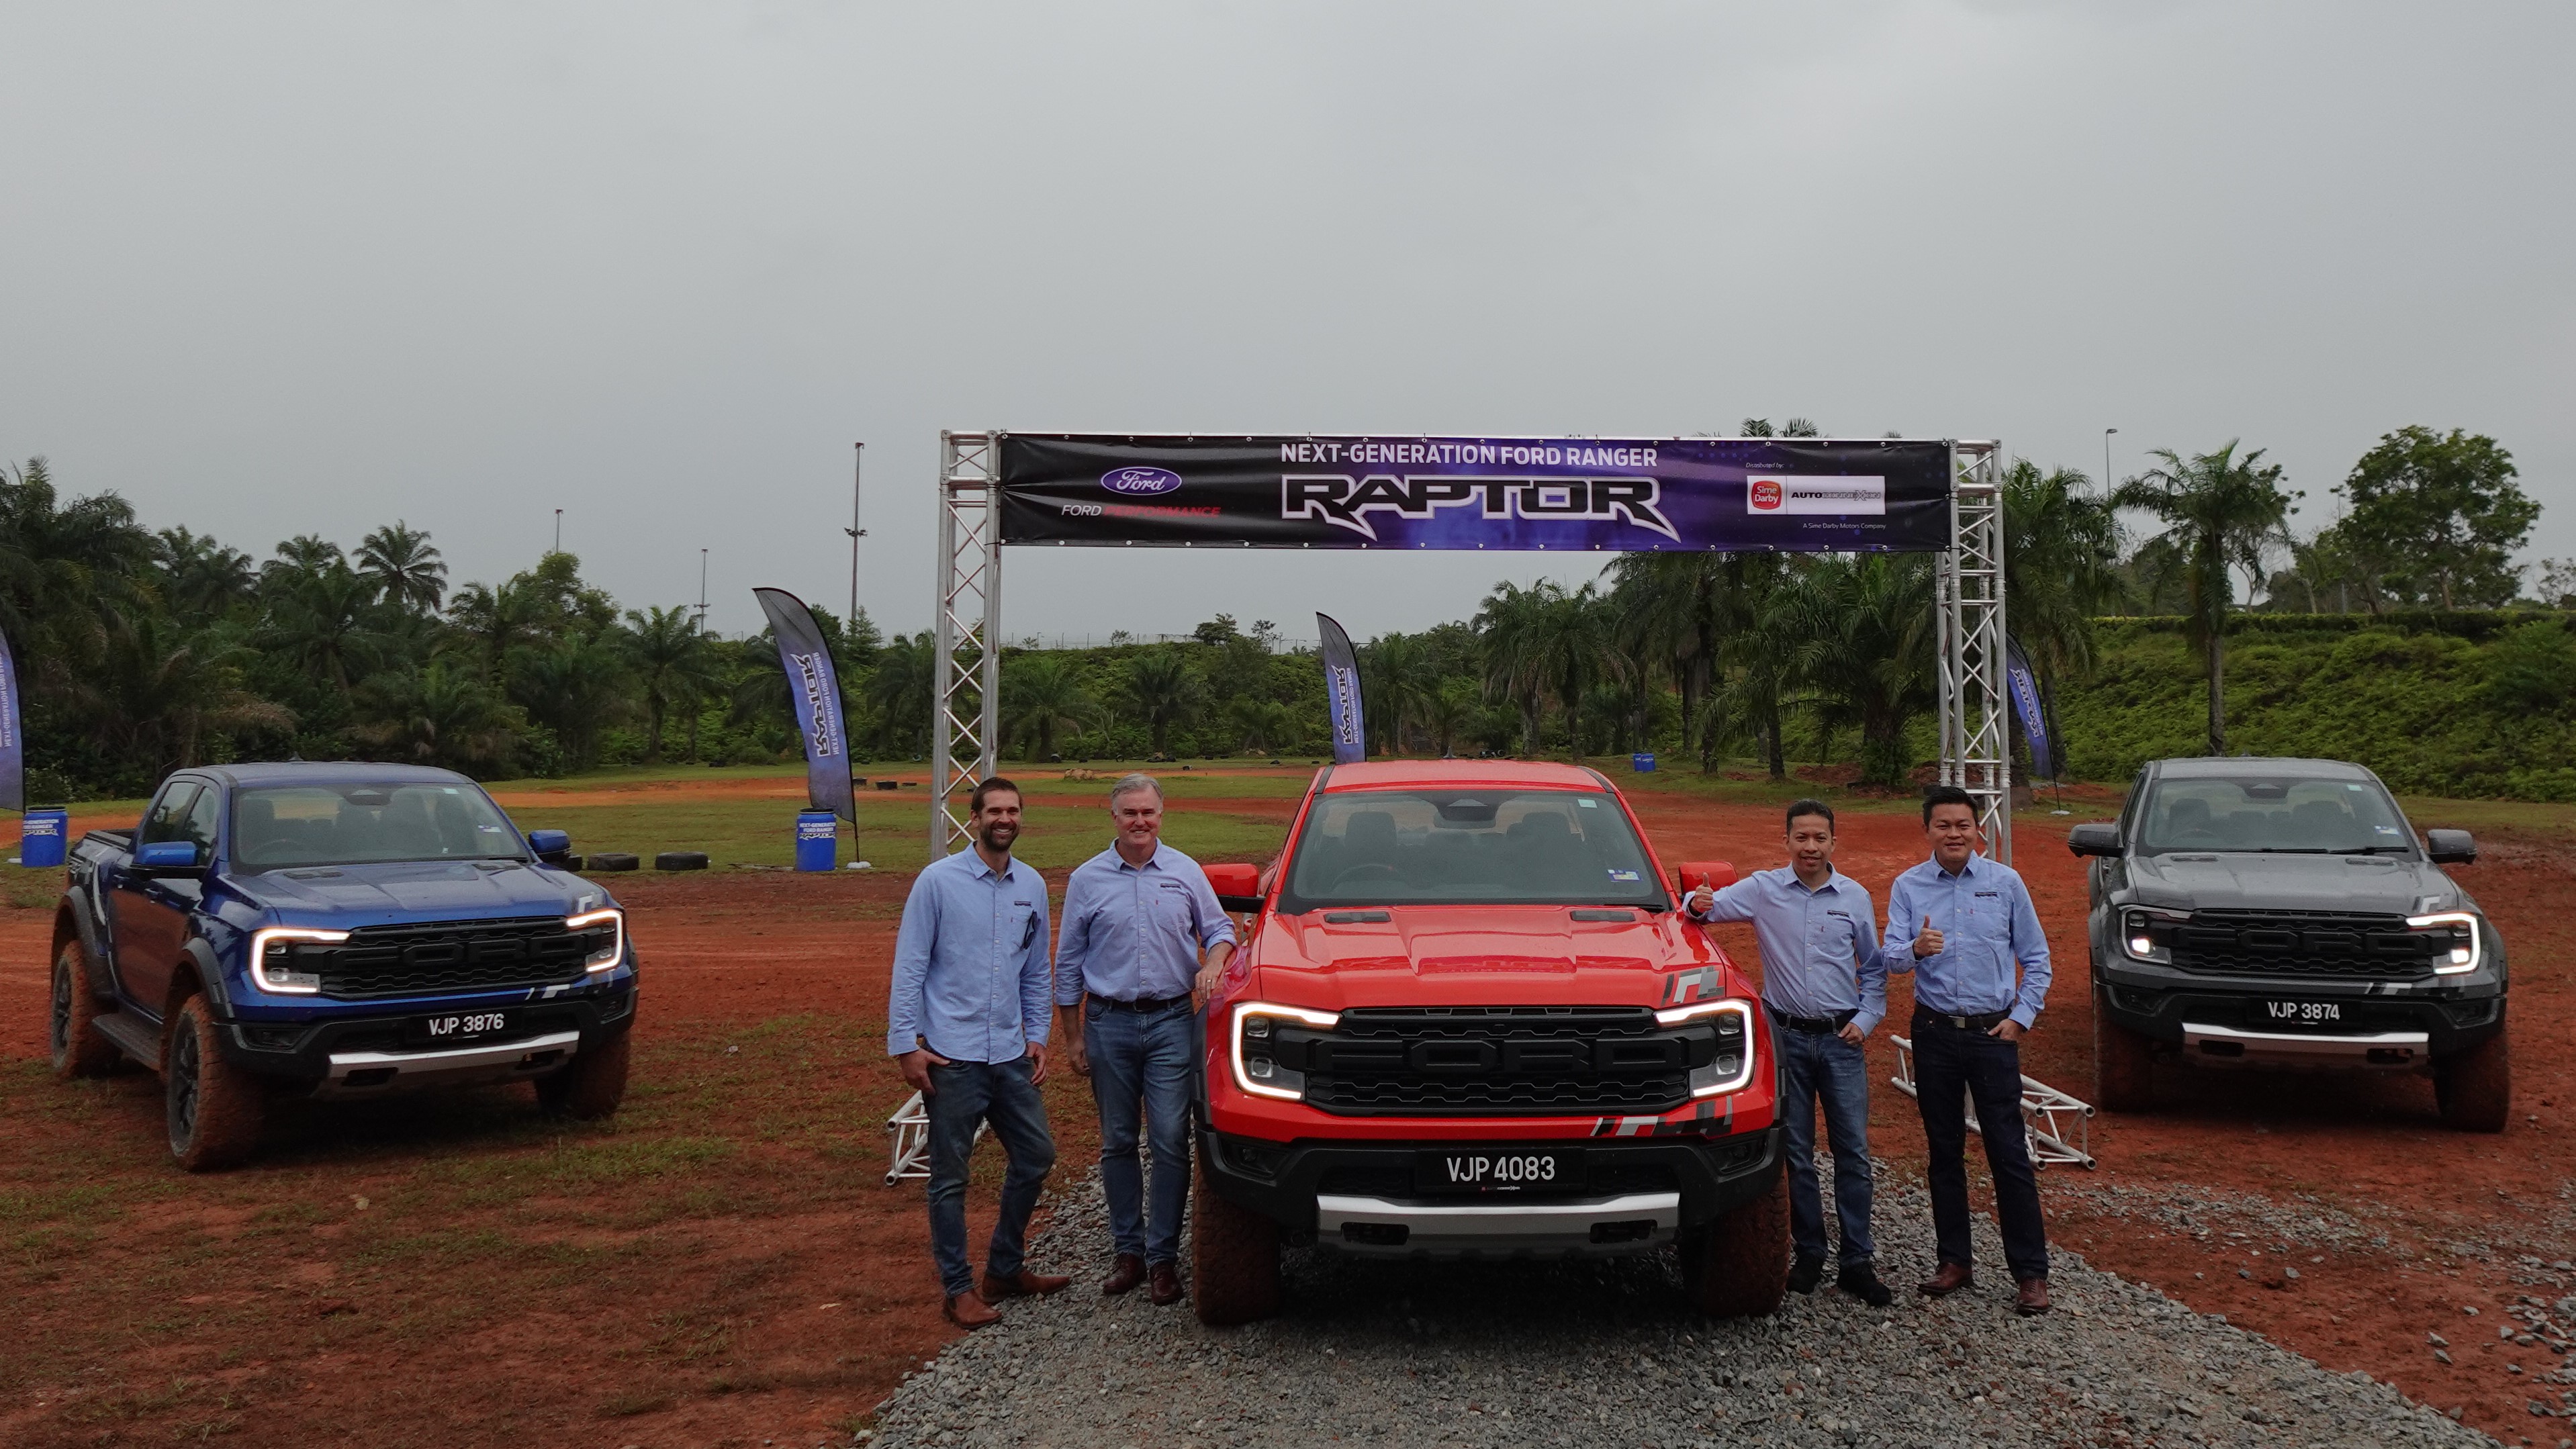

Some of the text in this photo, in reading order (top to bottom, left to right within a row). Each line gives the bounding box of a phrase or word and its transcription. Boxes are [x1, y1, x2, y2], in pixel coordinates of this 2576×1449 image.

[1281, 443, 1657, 467] NEXT-GENERATION FORD RANGER
[1116, 470, 1167, 491] Ford
[1757, 485, 1777, 494] Sime
[1282, 474, 1682, 543] RAPTOR
[1755, 494, 1779, 504] Darby
[1061, 504, 1222, 518] FORD PERFORMANCE
[2268, 1002, 2340, 1020] VJP 3874
[428, 1013, 504, 1035] VJP 3876
[1446, 1156, 1555, 1182] VJP 4083
